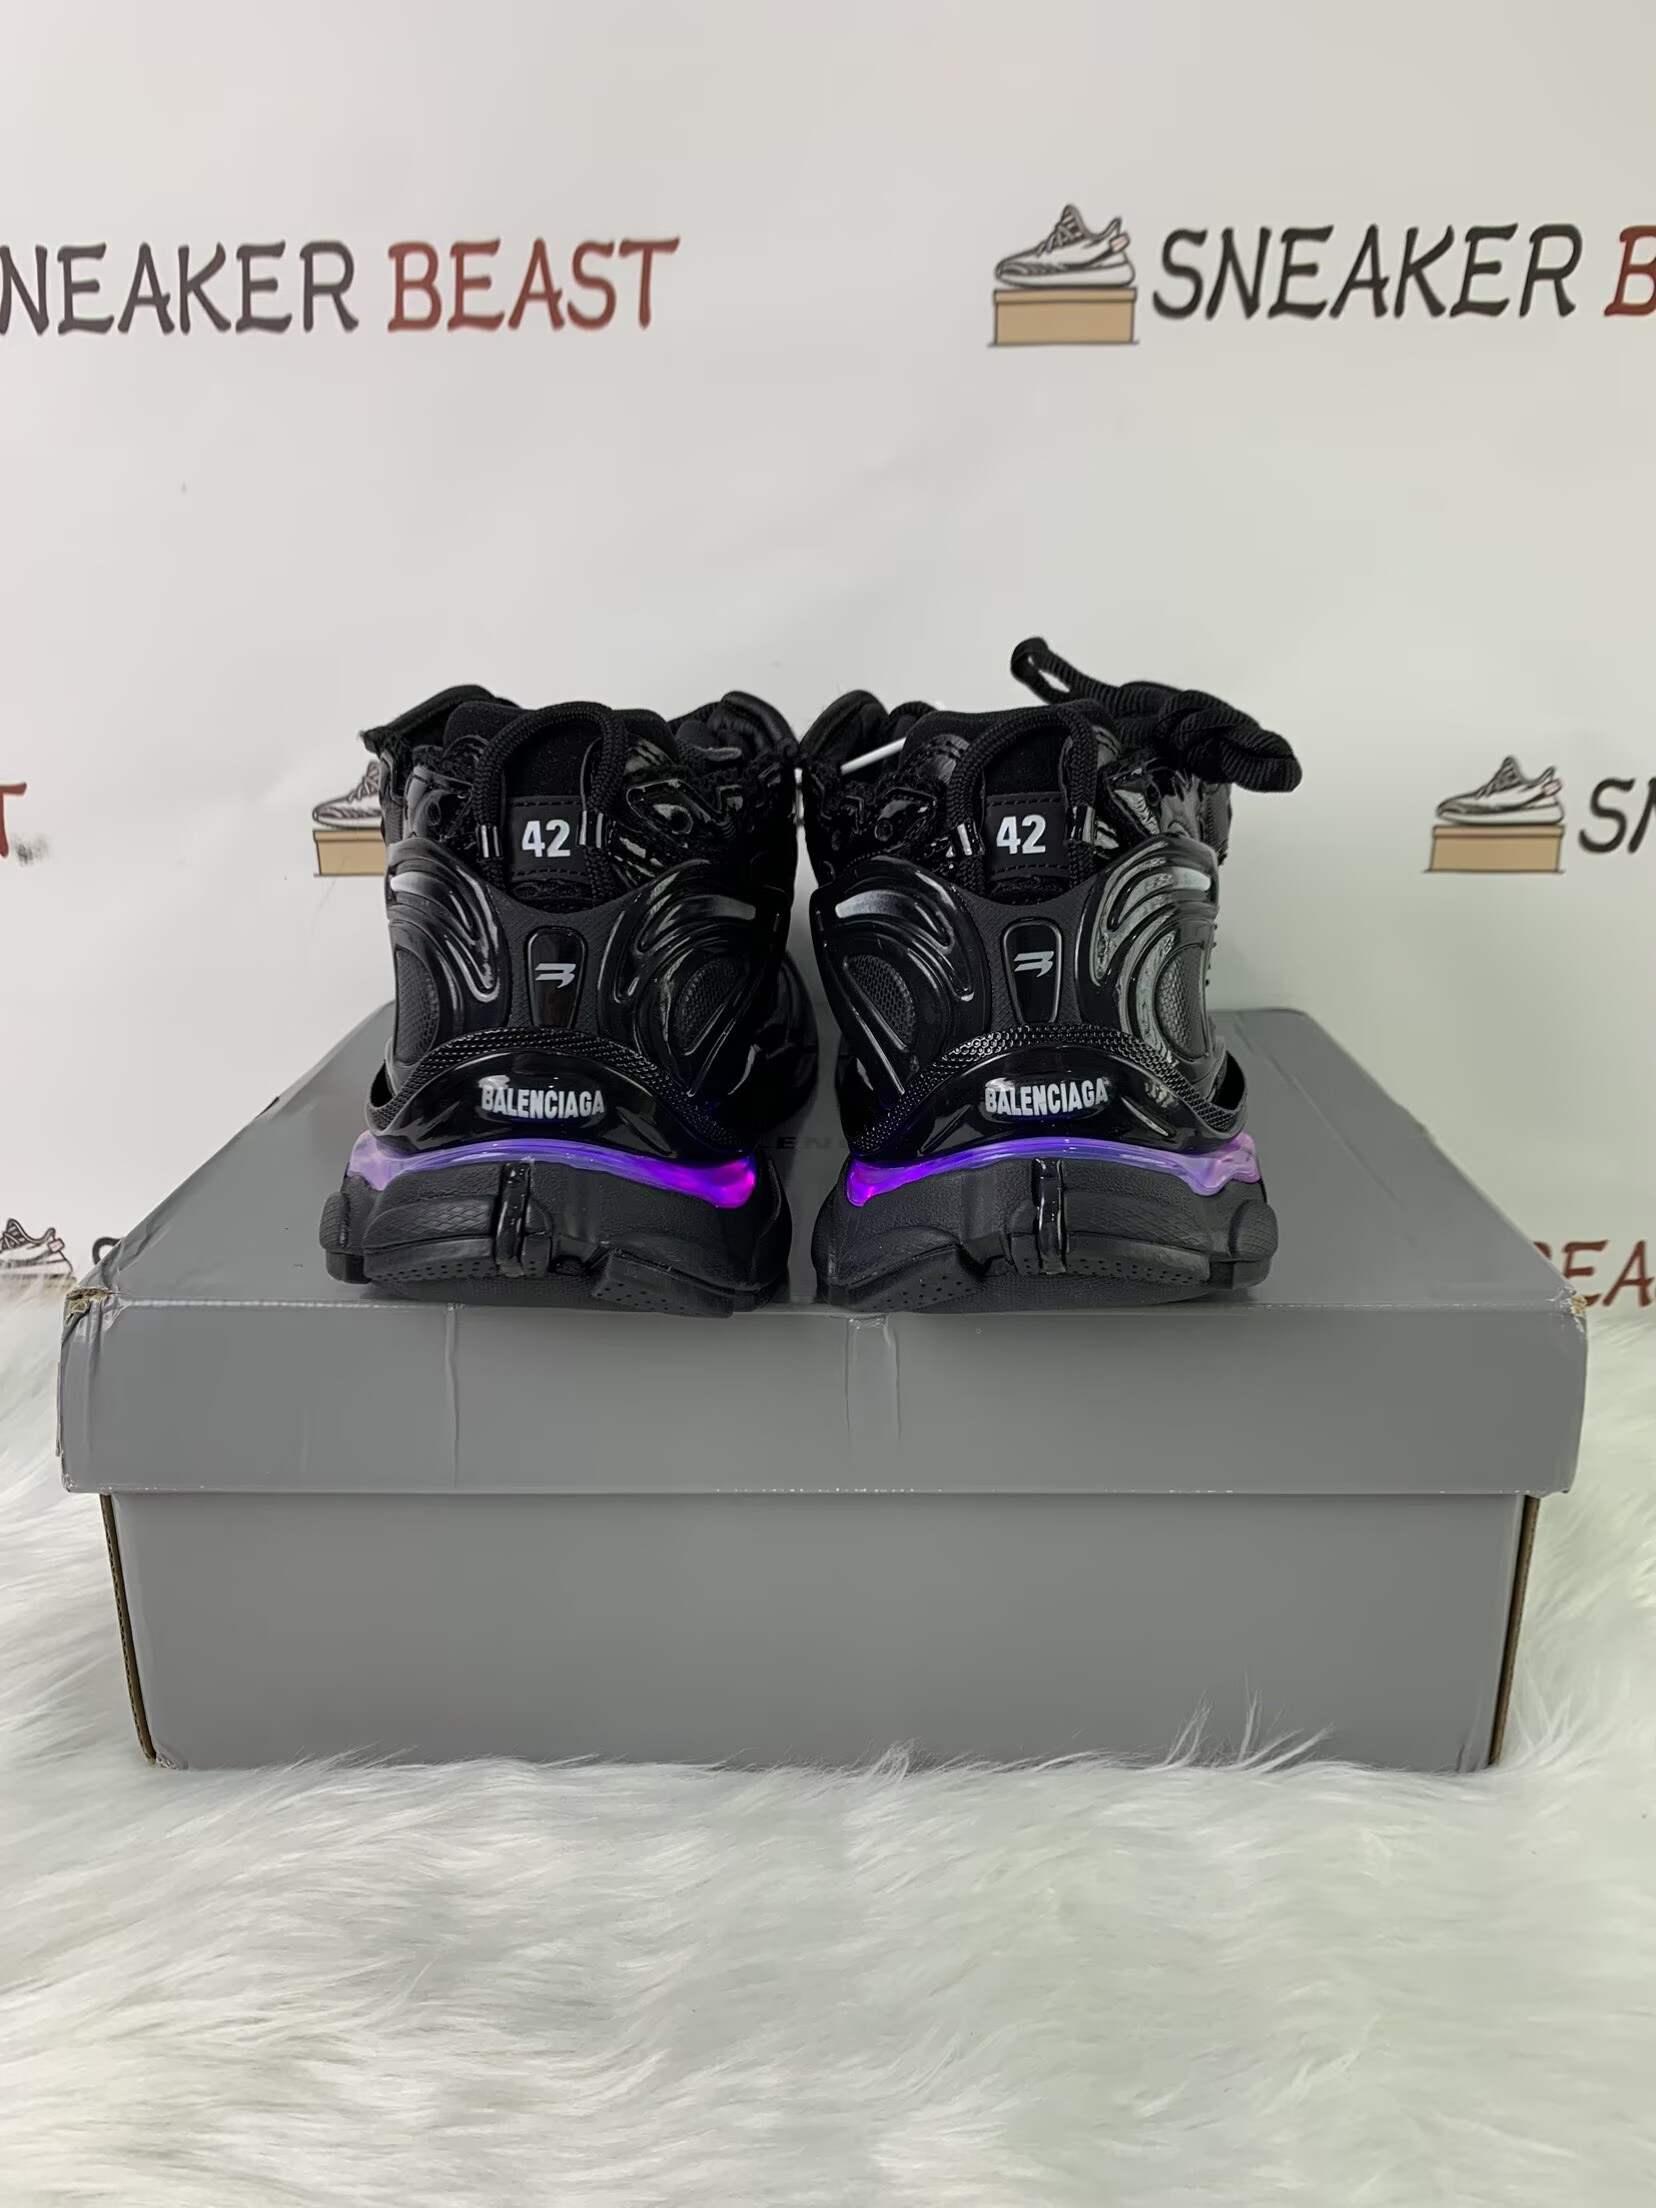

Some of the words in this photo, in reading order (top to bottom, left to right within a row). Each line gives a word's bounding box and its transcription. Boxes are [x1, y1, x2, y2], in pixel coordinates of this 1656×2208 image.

[388, 235, 681, 333] BEAST
[1153, 223, 1583, 320] SNEAKER
[521, 819, 571, 858] 42
[996, 814, 1047, 855] 42
[481, 1085, 605, 1120] BALENCIAGA
[985, 1078, 1109, 1117] BALENCIAGA
[1533, 1239, 1656, 1308] EA
